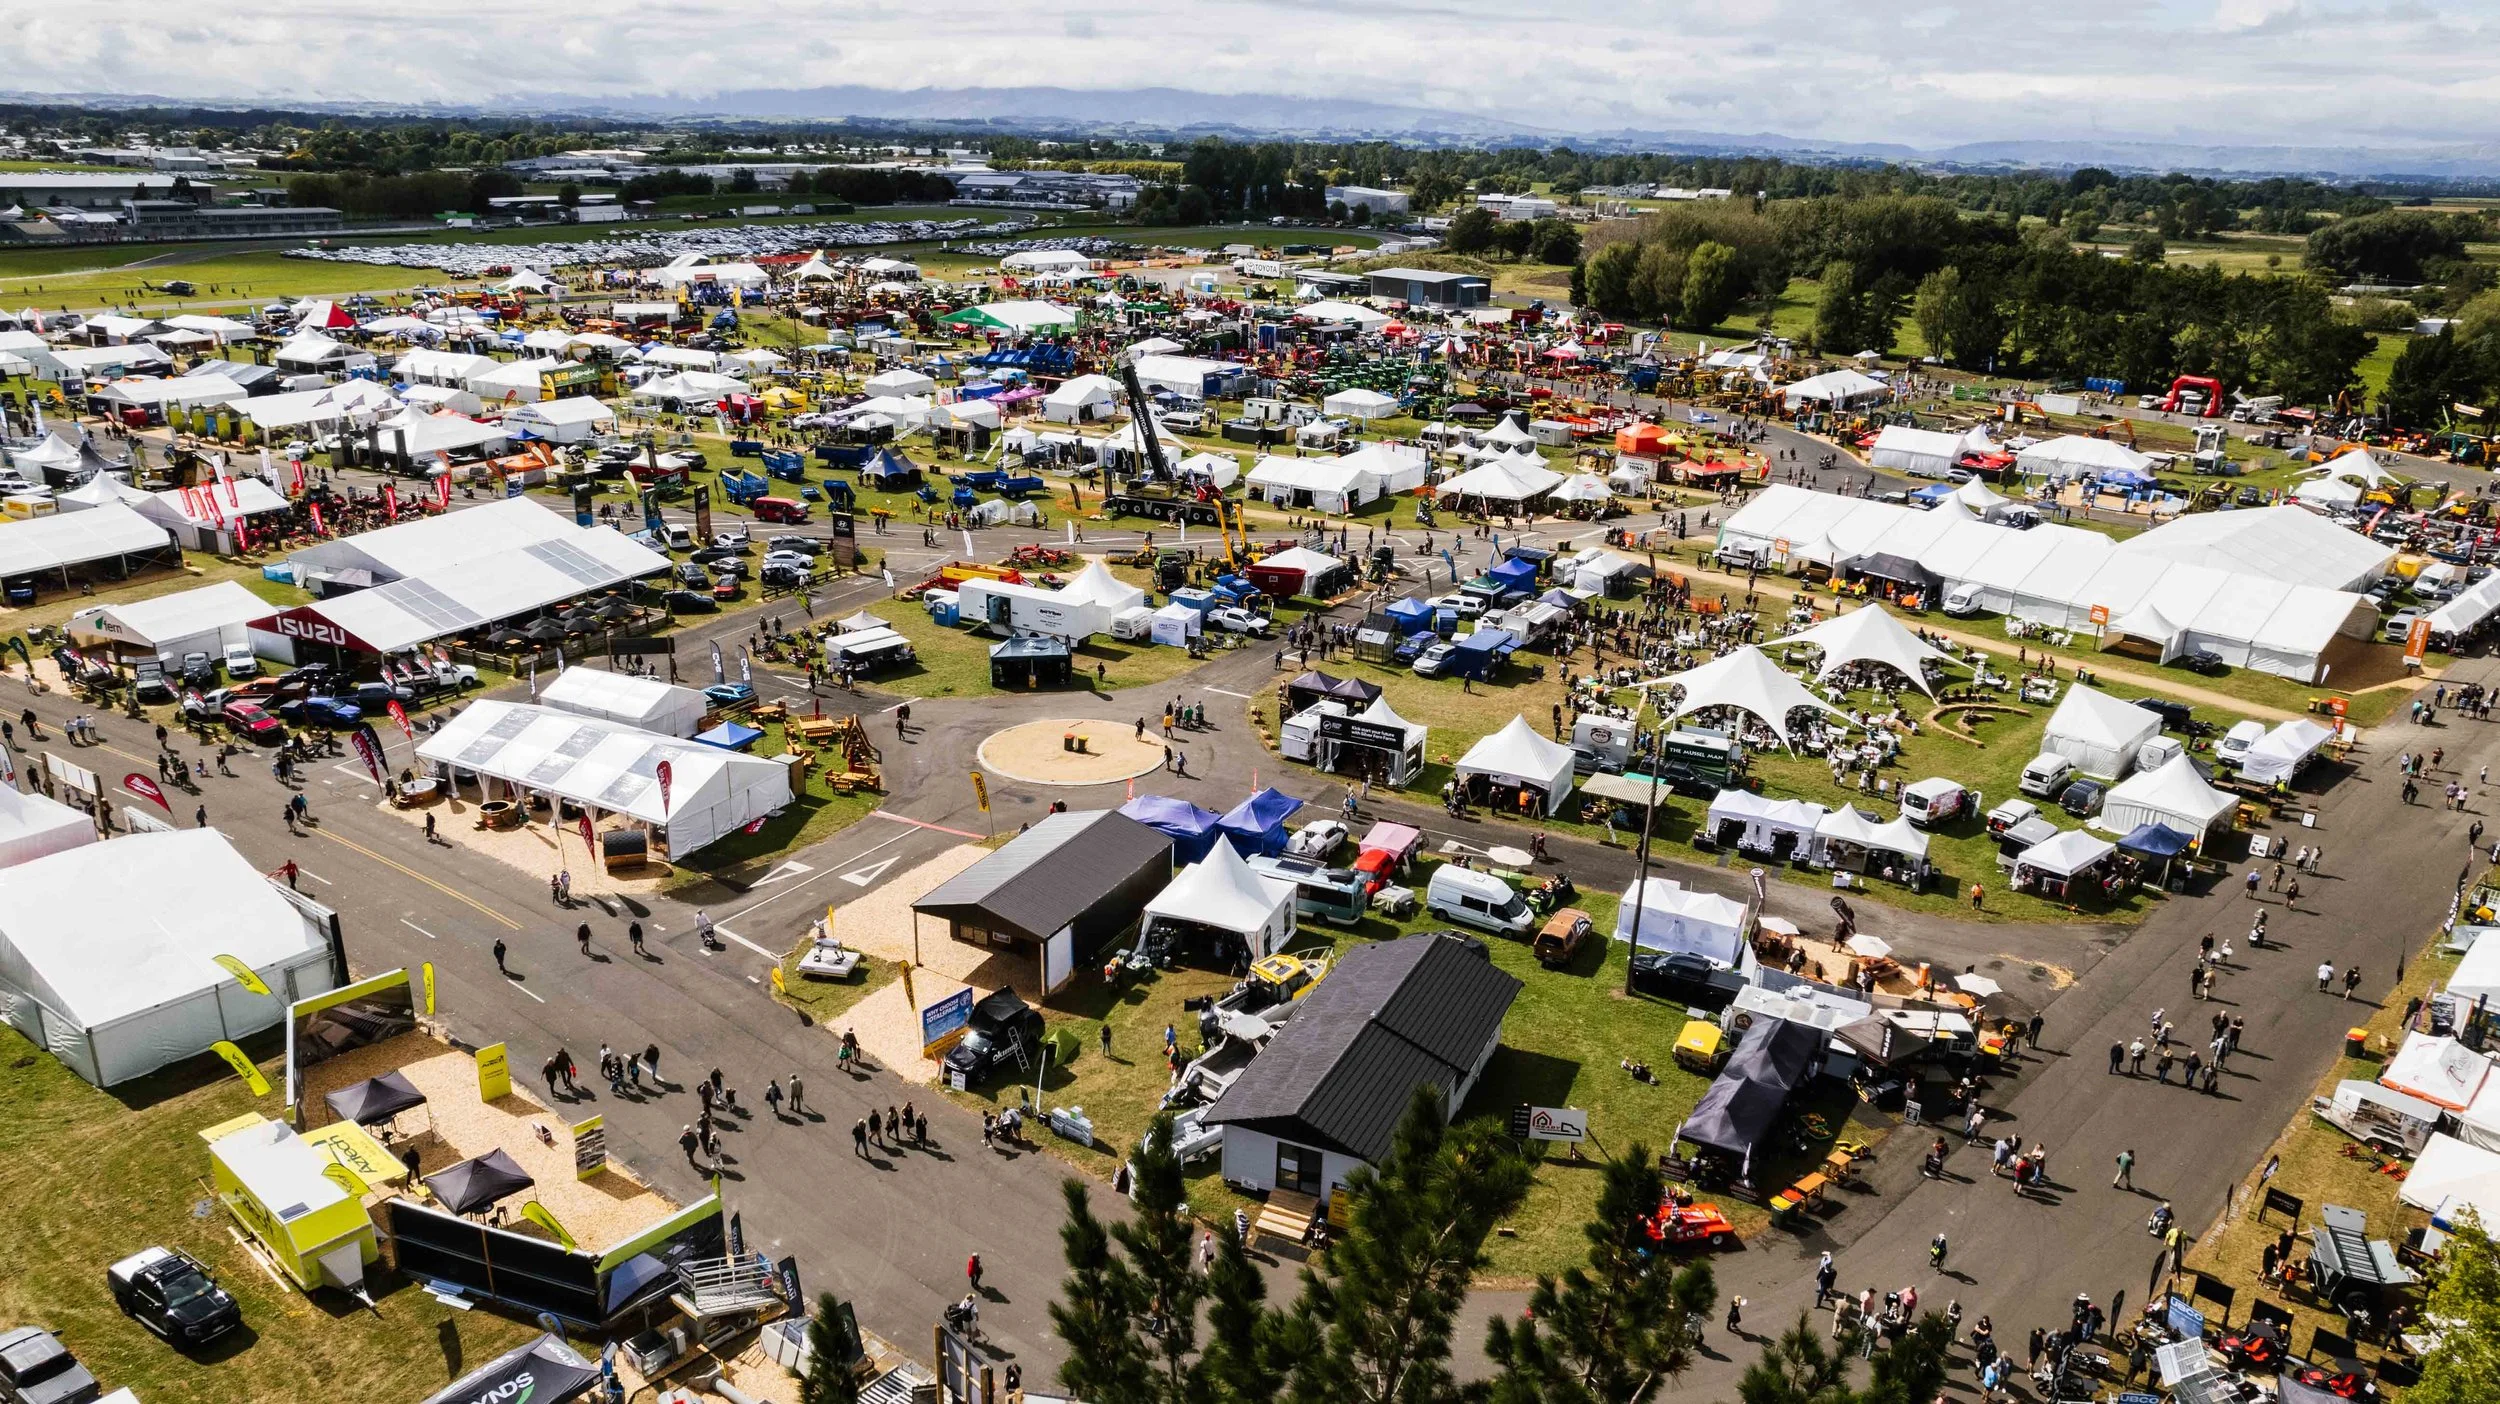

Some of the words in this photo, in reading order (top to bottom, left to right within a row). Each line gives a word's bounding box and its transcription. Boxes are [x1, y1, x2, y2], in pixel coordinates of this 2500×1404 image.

[1255, 264, 1278, 273] TOYOTA
[1134, 403, 1150, 436] MCINTOSH
[103, 620, 123, 634] fern
[276, 616, 346, 645] ISUZU
[368, 741, 385, 762] POOLS
[1683, 750, 1706, 758] MUSSEL
[926, 1007, 940, 1019] WHY
[940, 998, 959, 1013] CHOOSE
[926, 1005, 960, 1024] TOTALSPAN?
[329, 1135, 377, 1173] Aztech
[782, 1270, 799, 1301] HYNDS
[2170, 1297, 2203, 1321] UBCO
[468, 1372, 535, 1404] YNDS
[2120, 1393, 2160, 1404] UBCO
